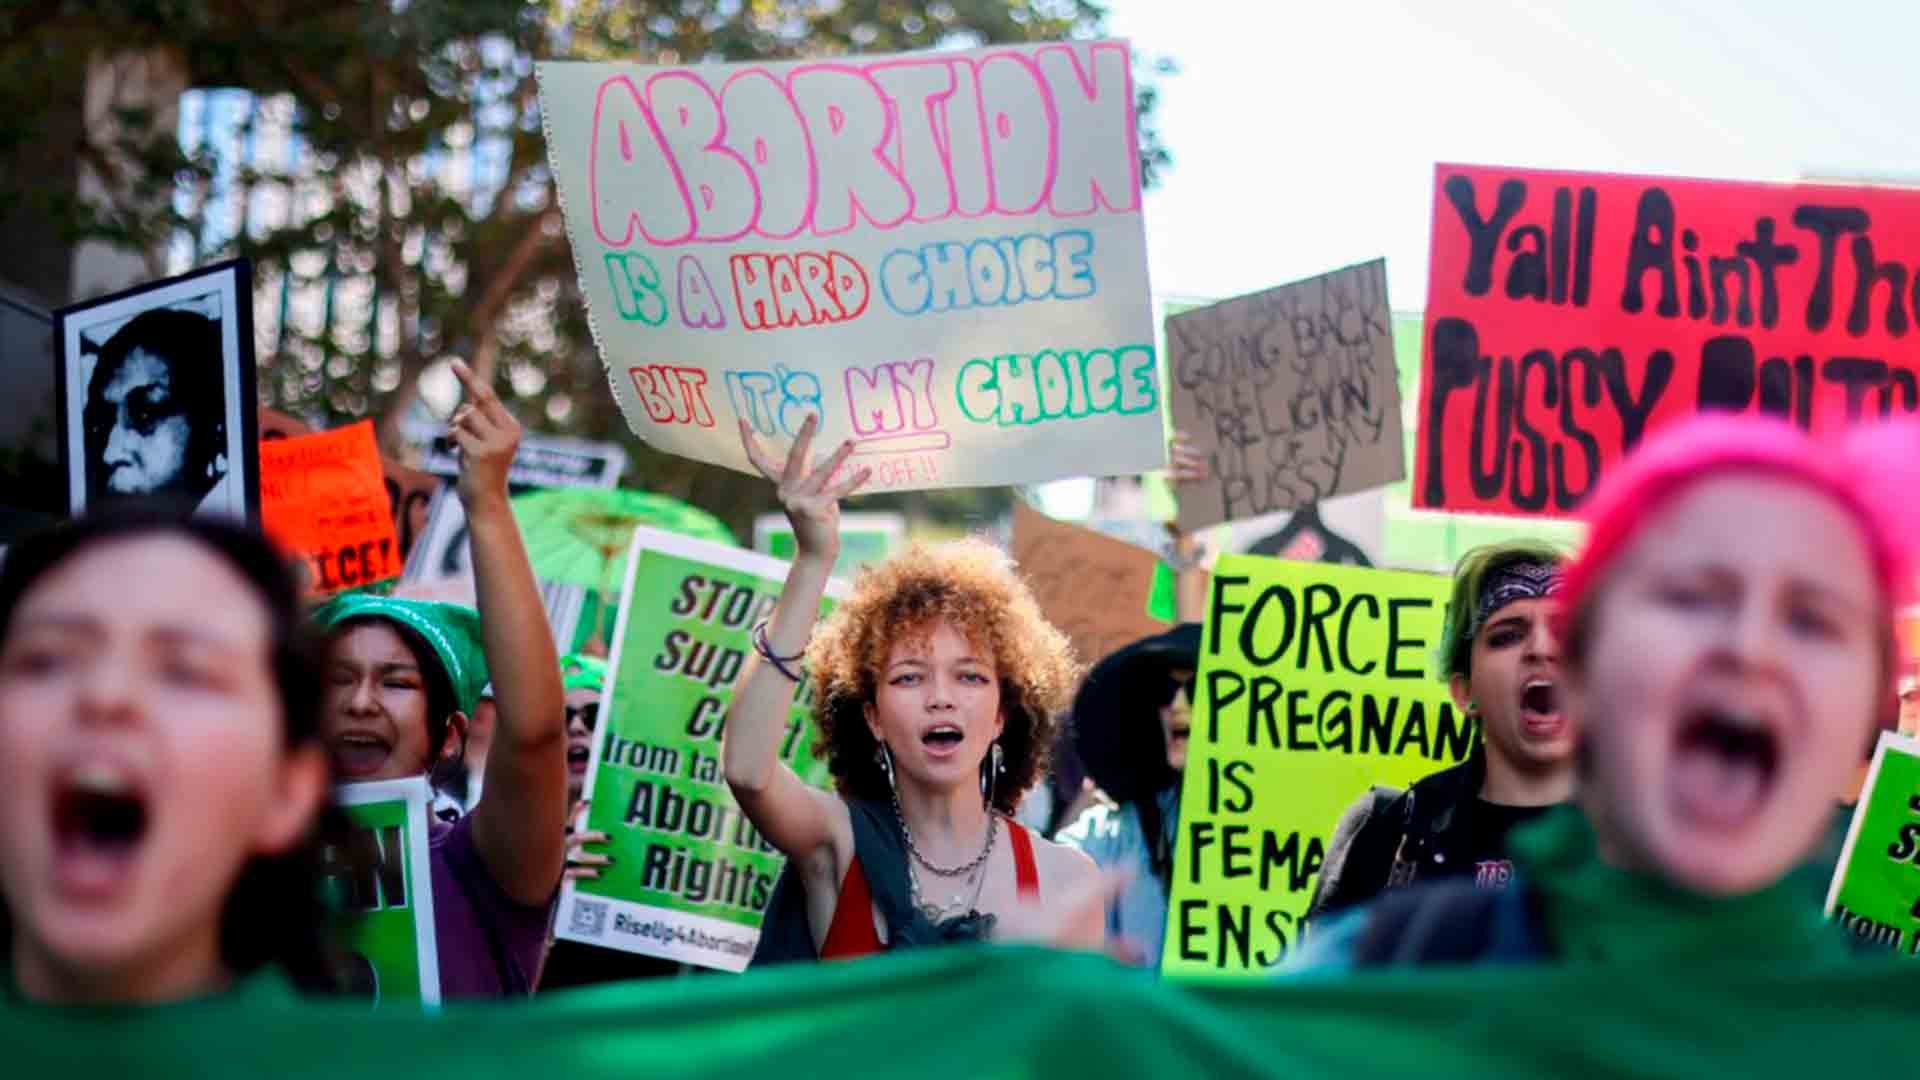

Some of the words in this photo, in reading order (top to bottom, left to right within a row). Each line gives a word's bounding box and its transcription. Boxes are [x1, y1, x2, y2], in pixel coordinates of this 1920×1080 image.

[589, 40, 1142, 247] ABORTION
[603, 252, 669, 326] IS
[677, 255, 727, 329] A
[730, 250, 870, 331] HARD
[879, 229, 1097, 316] CHOICE
[1443, 173, 1598, 307] Yall
[1619, 186, 1799, 331] Aint
[1792, 204, 1920, 338] Th
[1291, 307, 1387, 360] BACK
[629, 364, 716, 428] BUT
[843, 358, 937, 438] MY
[956, 344, 1158, 426] CHOICE
[1221, 451, 1348, 520] PUSSY
[1210, 575, 1450, 679] FORCE
[690, 749, 724, 784] ta
[1209, 757, 1255, 815] IS
[641, 844, 772, 912] Rights
[1180, 900, 1305, 969] ENS
